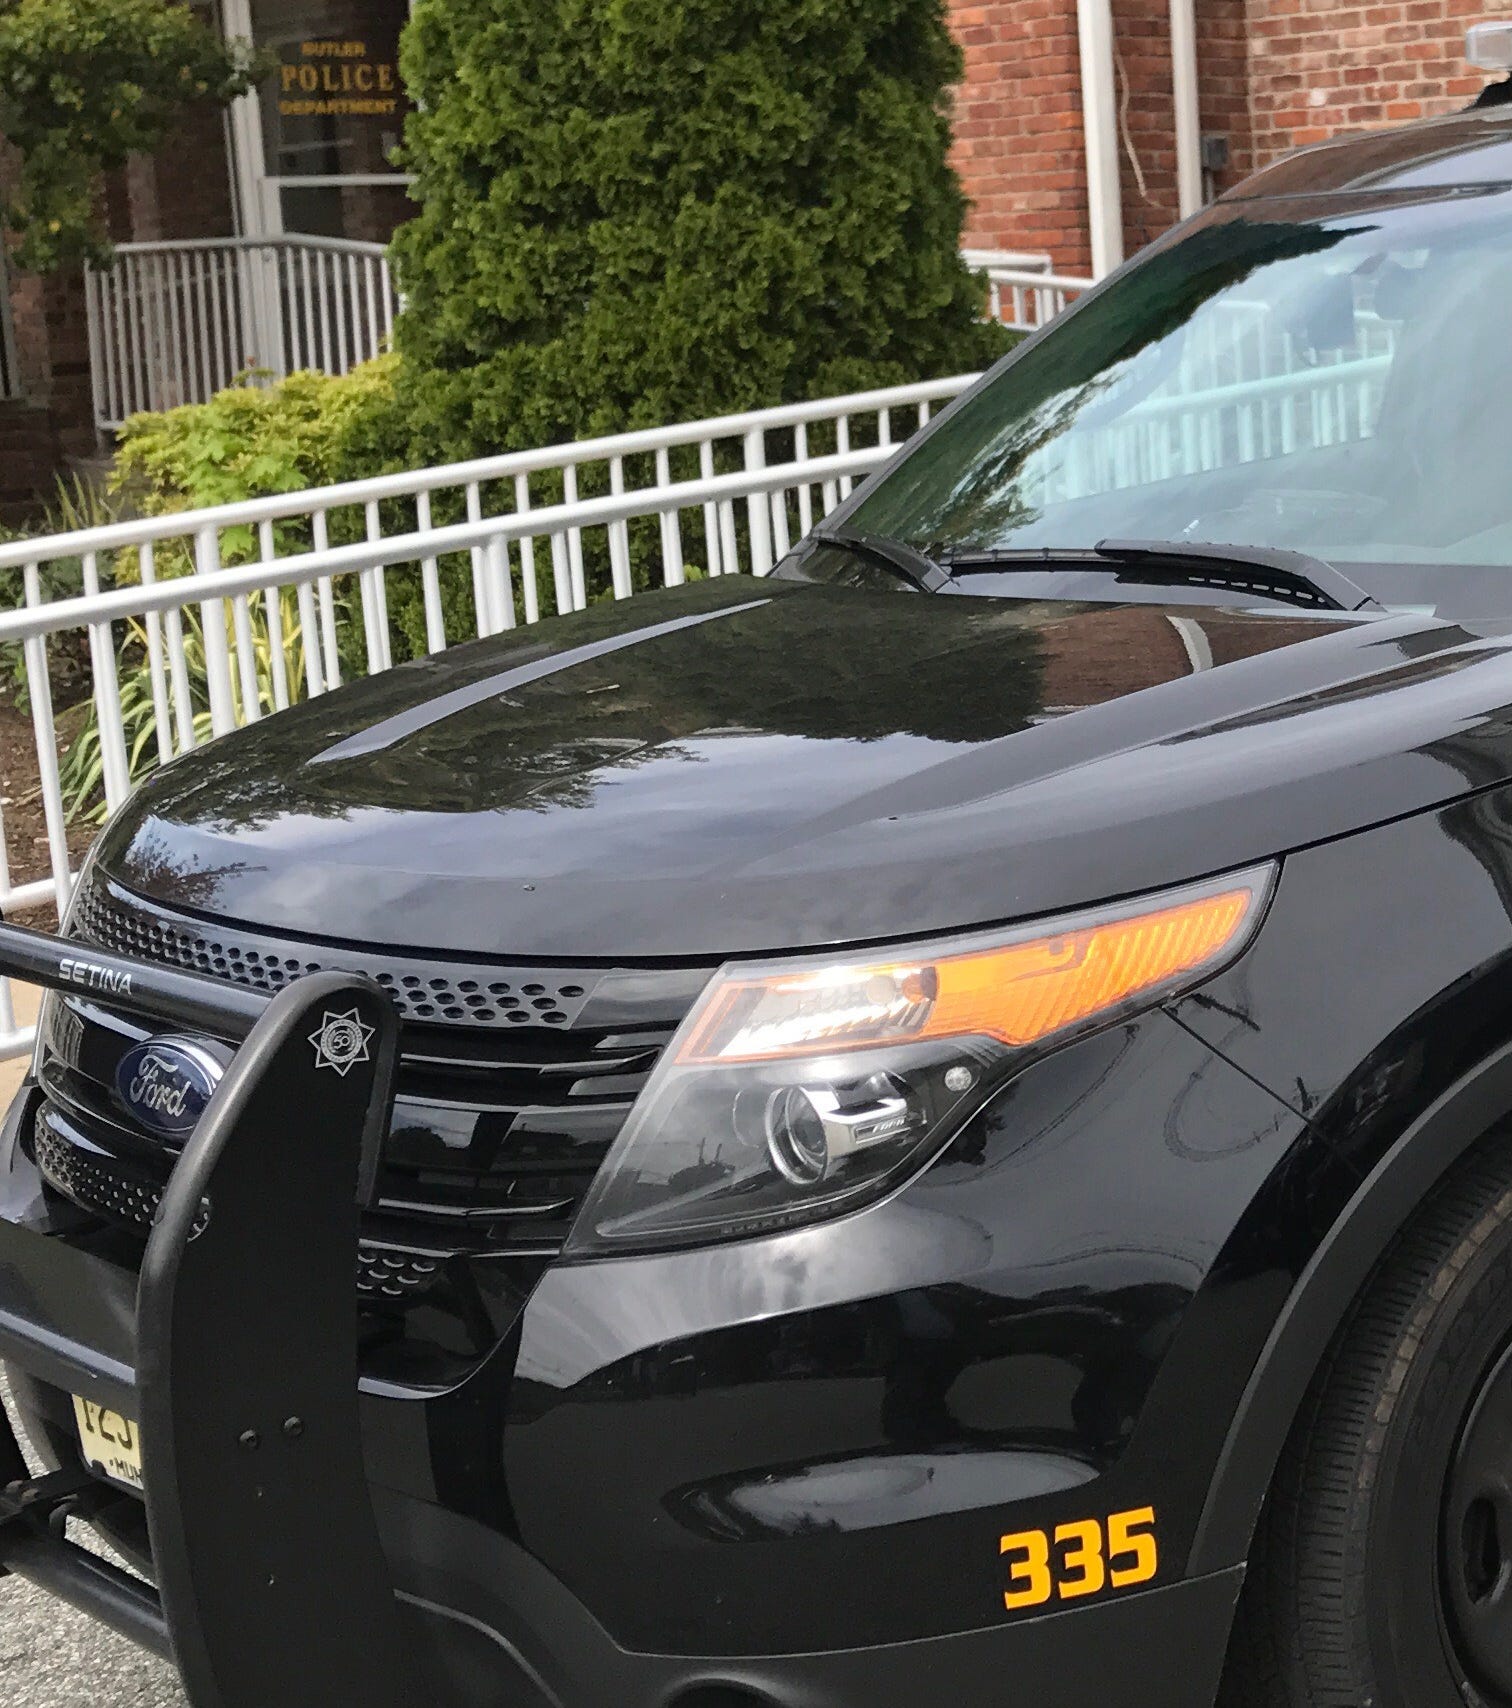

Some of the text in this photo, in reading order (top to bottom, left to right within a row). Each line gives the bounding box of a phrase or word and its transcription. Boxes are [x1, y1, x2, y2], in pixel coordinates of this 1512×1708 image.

[281, 63, 394, 92] POLICE
[280, 98, 396, 115] DEPARTMENT
[59, 958, 132, 995] SETINA
[130, 1054, 191, 1117] Ford
[1000, 1506, 1157, 1610] 335
